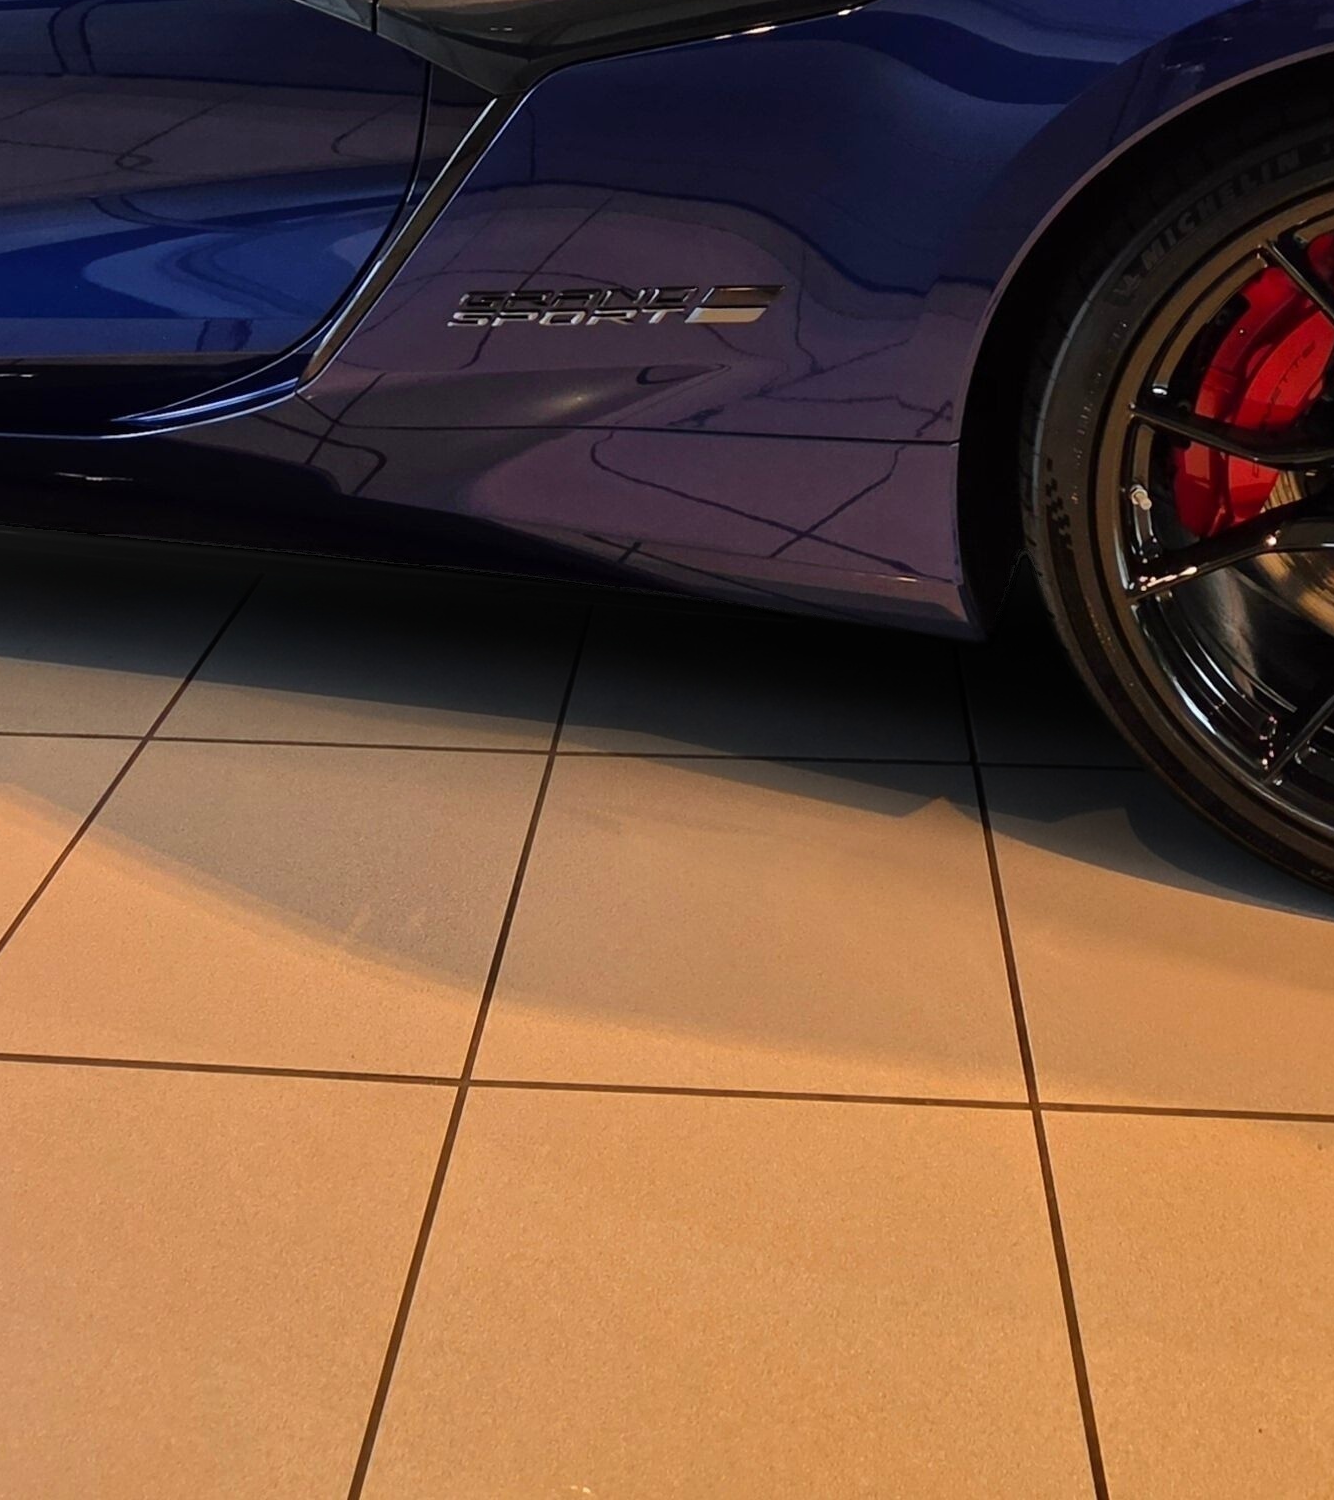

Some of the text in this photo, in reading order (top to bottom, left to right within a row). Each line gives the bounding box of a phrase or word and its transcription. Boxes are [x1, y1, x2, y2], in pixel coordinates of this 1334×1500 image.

[1141, 149, 1300, 271] MICHELIN
[459, 286, 699, 308] GRAND
[446, 308, 686, 328] SPORT
